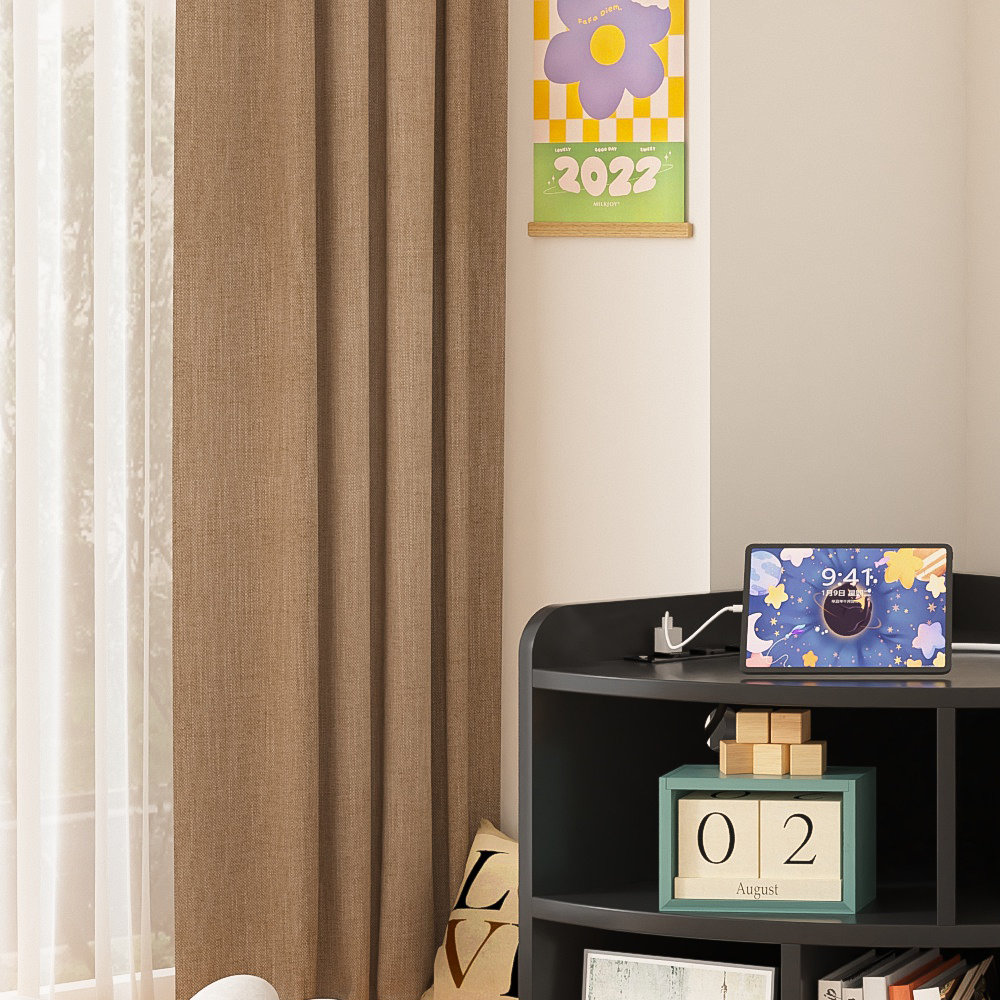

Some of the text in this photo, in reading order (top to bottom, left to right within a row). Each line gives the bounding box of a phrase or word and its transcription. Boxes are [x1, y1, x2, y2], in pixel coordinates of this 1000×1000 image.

[554, 156, 662, 197] 2022
[822, 568, 870, 586] 9:41
[782, 813, 817, 865] 2
[736, 882, 779, 900] August
